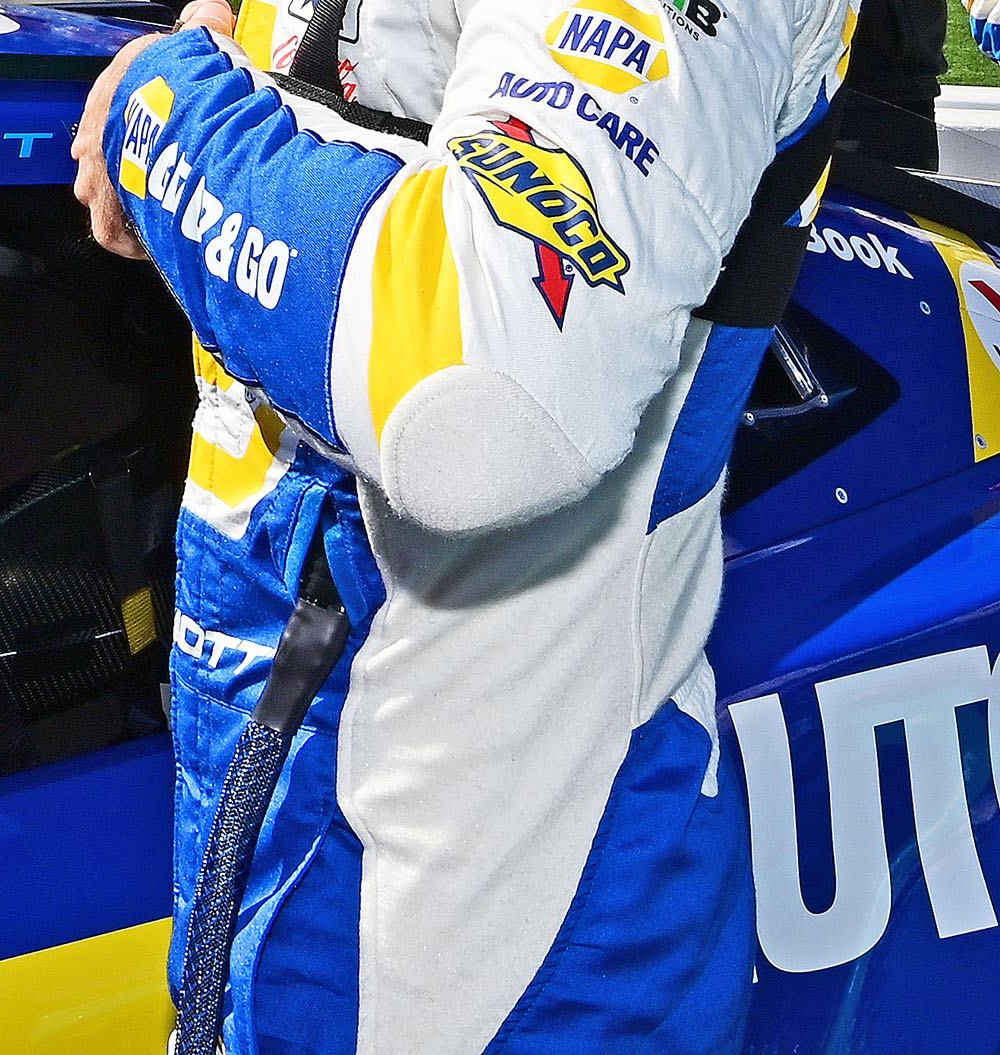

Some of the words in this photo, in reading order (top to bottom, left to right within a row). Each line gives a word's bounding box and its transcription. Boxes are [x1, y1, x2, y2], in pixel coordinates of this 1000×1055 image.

[559, 13, 650, 75] NAPA
[452, 137, 620, 276] SUNOCO
[727, 644, 1000, 974] UT
